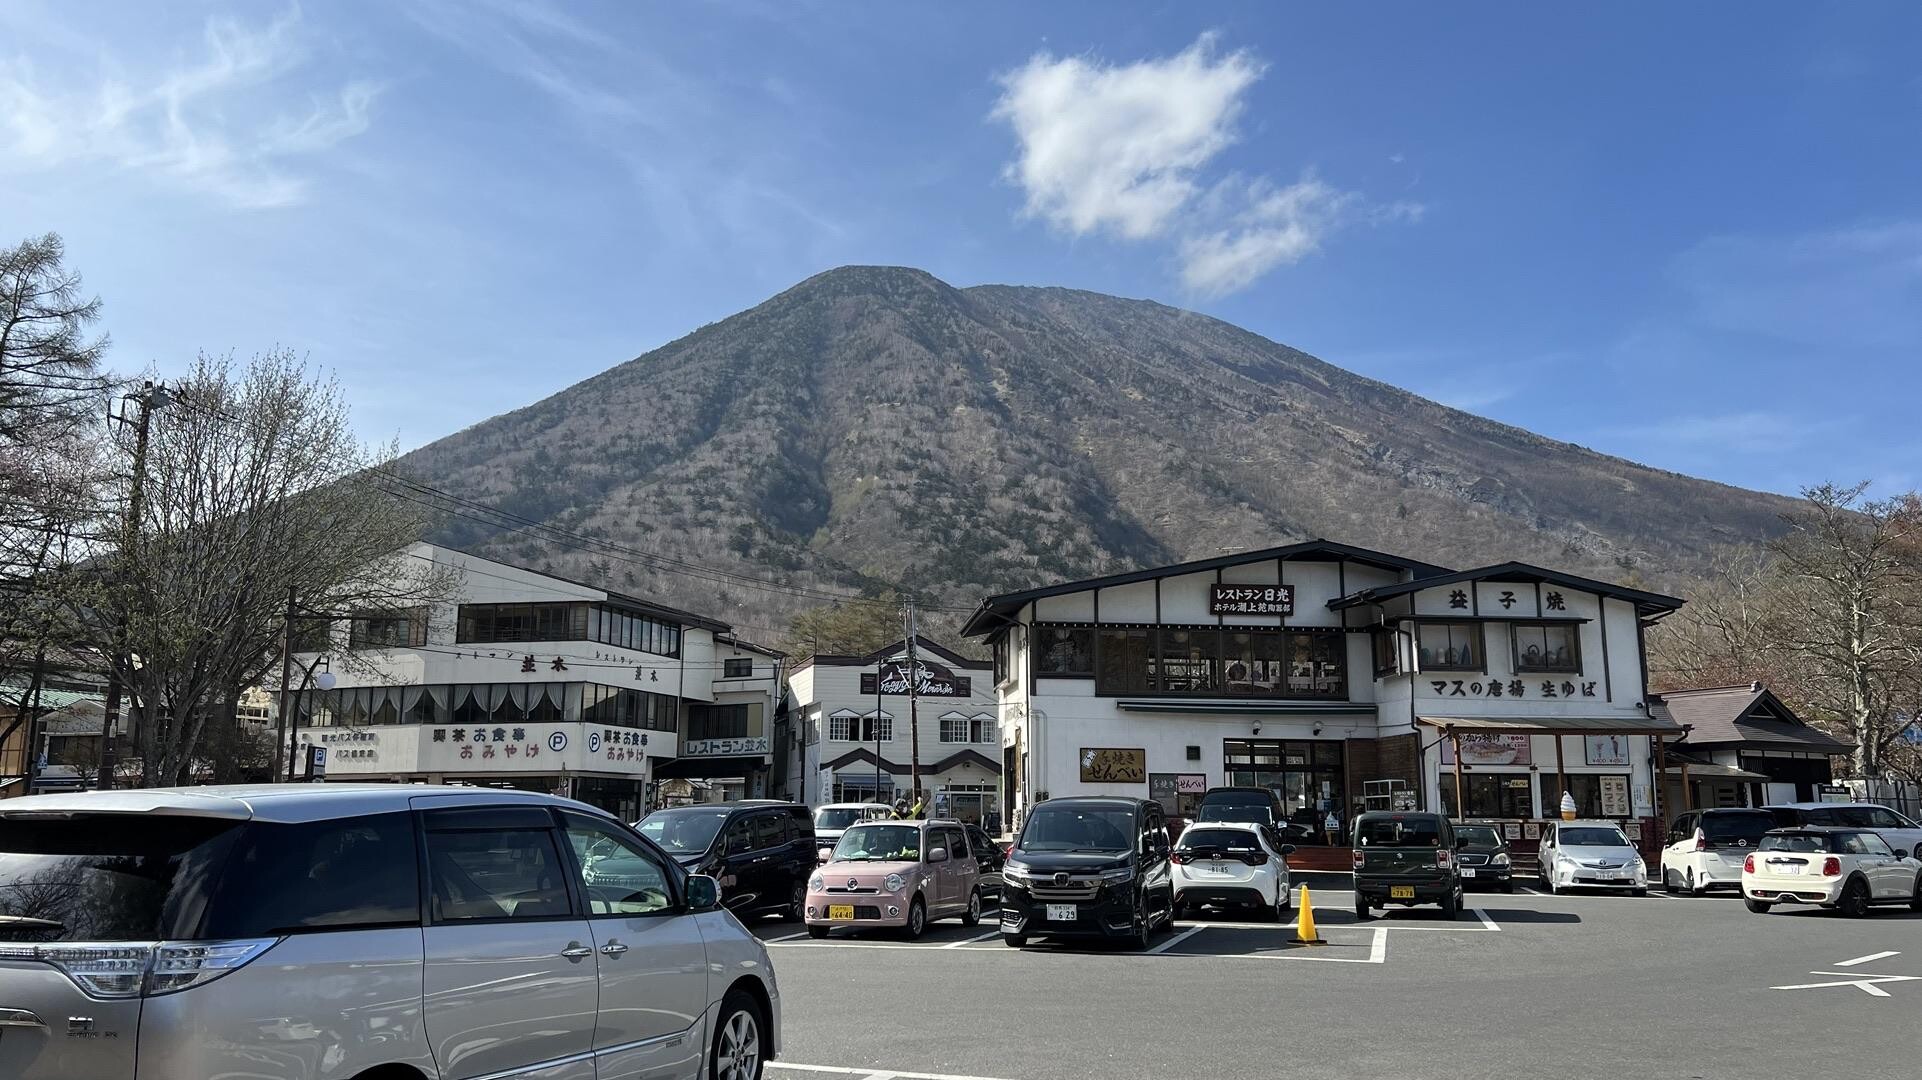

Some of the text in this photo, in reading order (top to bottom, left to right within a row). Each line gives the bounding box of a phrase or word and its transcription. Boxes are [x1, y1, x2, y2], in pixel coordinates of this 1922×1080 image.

[1216, 588, 1290, 602] レストラン日光
[1449, 589, 1566, 611] 益子焼
[520, 654, 568, 673] 並木
[634, 665, 659, 682] 並木
[1431, 679, 1597, 698] マスの唐揚 生ゆば
[686, 738, 767, 754] レストラン並木
[1089, 764, 1143, 781] せんべい
